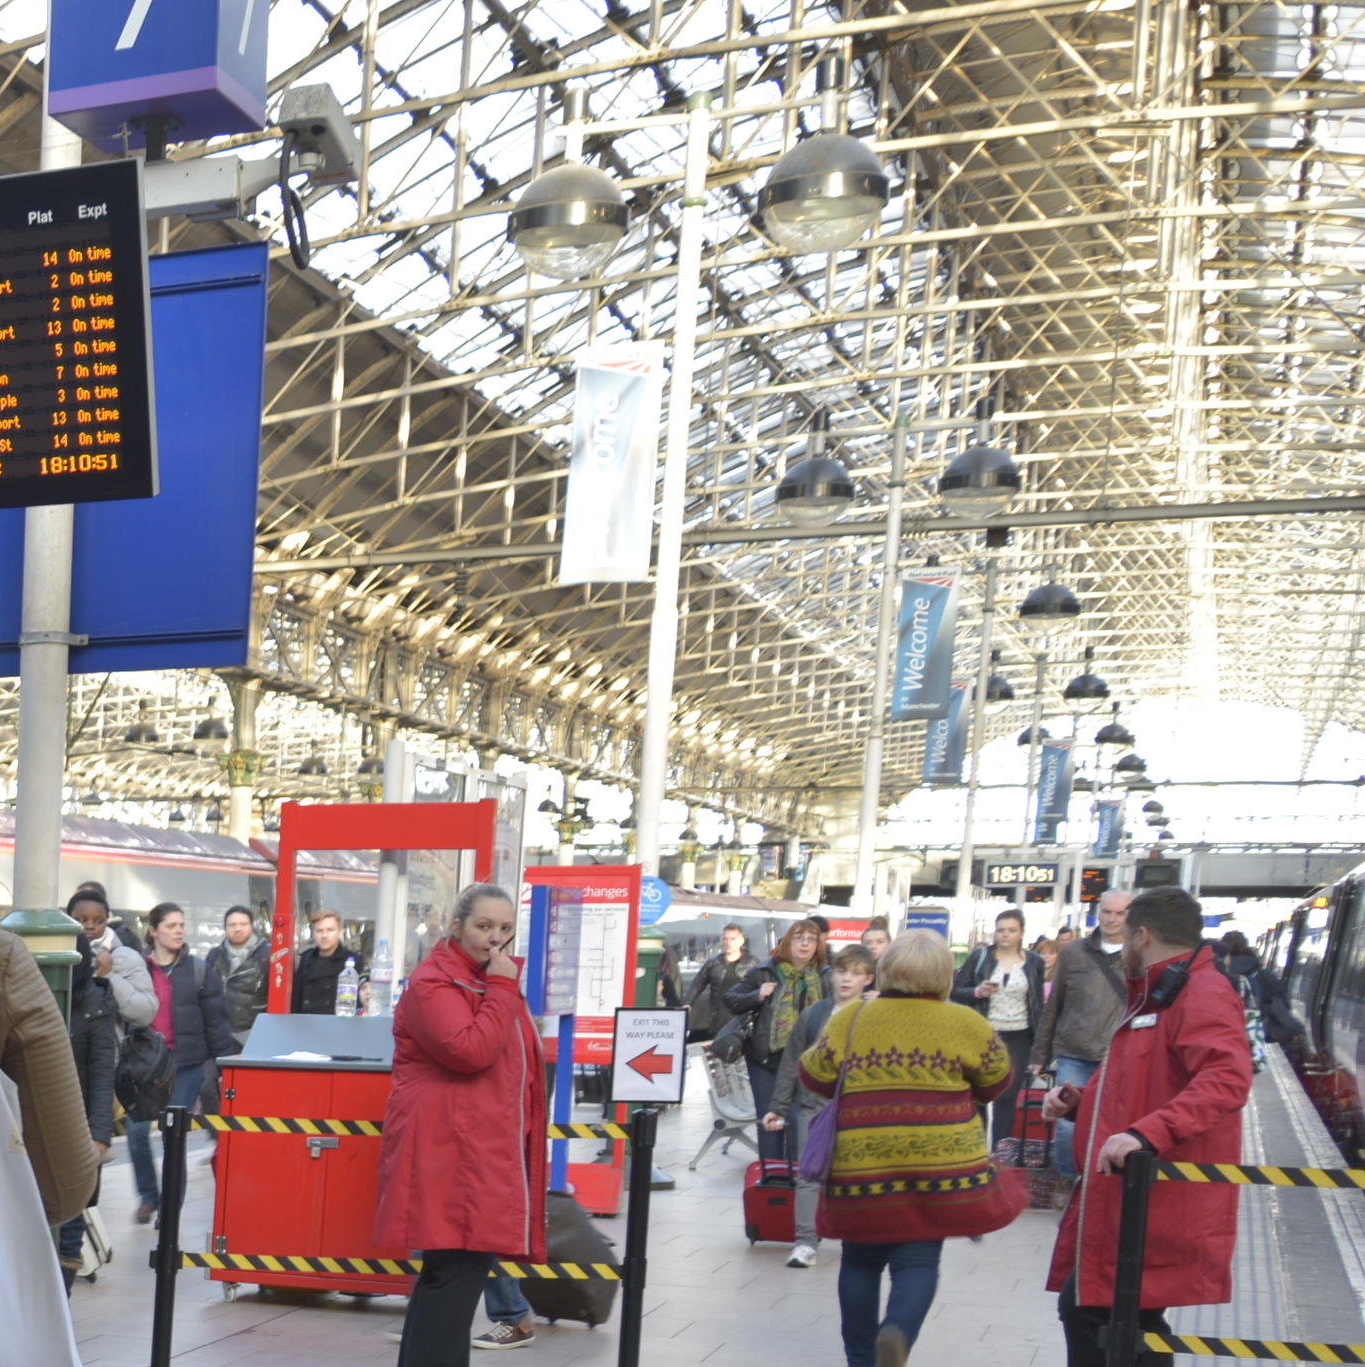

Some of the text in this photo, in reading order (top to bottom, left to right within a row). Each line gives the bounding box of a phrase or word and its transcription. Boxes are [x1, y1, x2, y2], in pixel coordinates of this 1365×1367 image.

[28, 210, 53, 225] Plat
[78, 203, 107, 219] Expt
[43, 252, 57, 266] 14
[68, 249, 82, 263] On
[87, 246, 111, 261] time
[51, 274, 58, 288] 2
[53, 298, 60, 312] 2
[48, 321, 61, 335] 13
[55, 343, 63, 357] 5
[74, 342, 88, 355] On
[92, 340, 116, 353] time
[57, 366, 63, 379] 7
[58, 389, 65, 402] 3
[53, 411, 66, 425] 13
[0, 439, 12, 452] St
[54, 434, 67, 448] 14
[79, 432, 92, 445] On
[96, 431, 120, 444] time
[41, 454, 118, 475] 18:10:51
[902, 597, 931, 690] Welcome
[930, 719, 950, 763] Welco
[1041, 754, 1058, 807] Welcome
[582, 887, 628, 899] changes
[652, 1018, 670, 1026] THIS
[626, 1031, 675, 1039] WAY PLEASE
